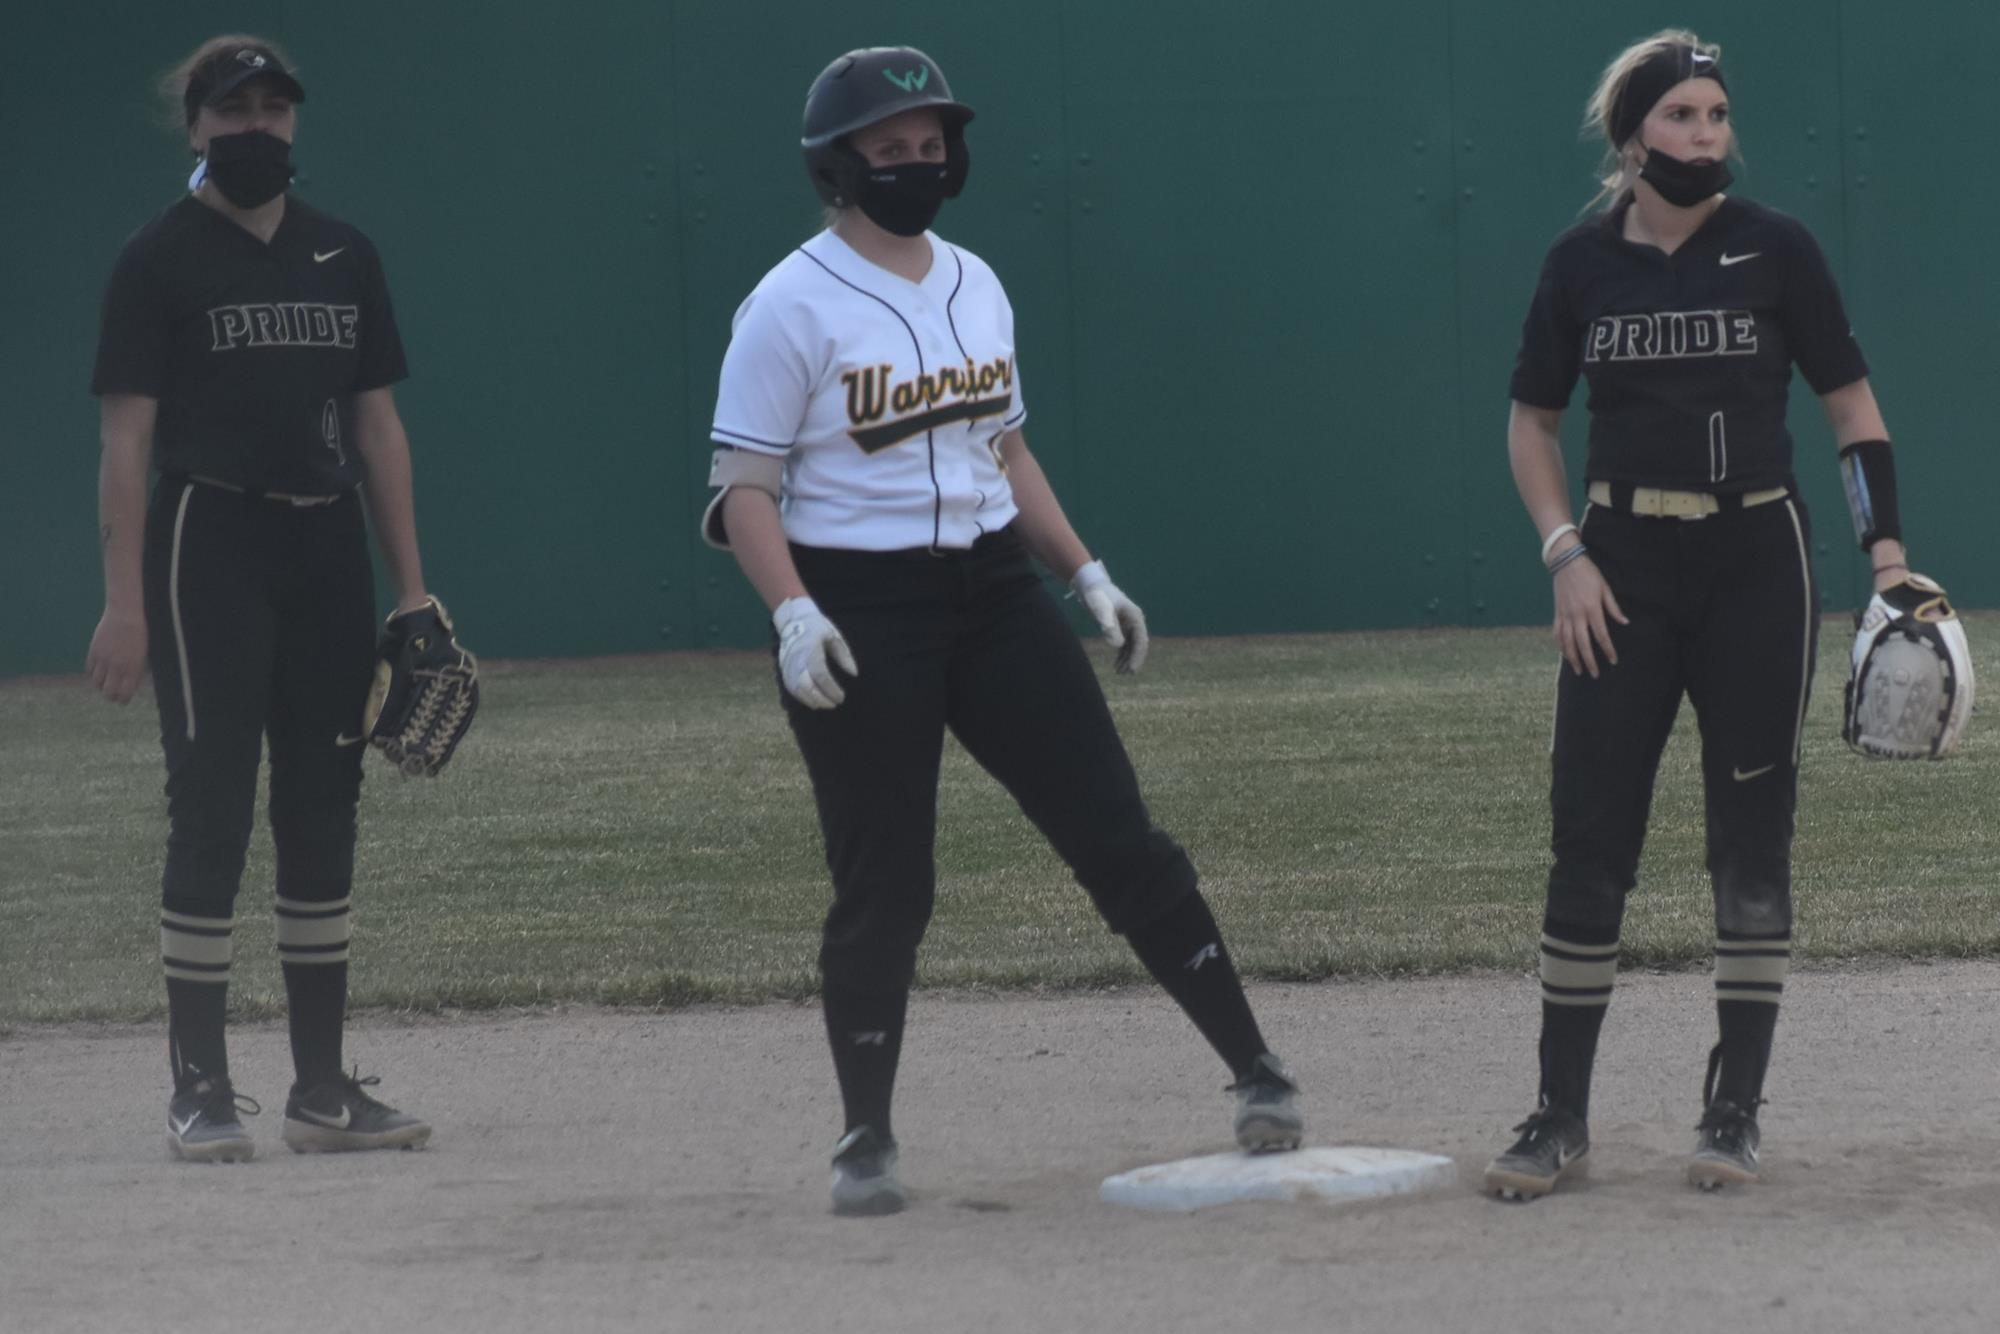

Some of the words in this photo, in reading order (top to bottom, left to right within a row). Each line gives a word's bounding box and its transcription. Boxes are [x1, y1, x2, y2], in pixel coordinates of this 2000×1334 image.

[207, 303, 358, 351] PRIDE
[1585, 310, 1758, 362] PRIDE
[841, 353, 1013, 425] Warrior
[1709, 411, 1727, 483] 1
